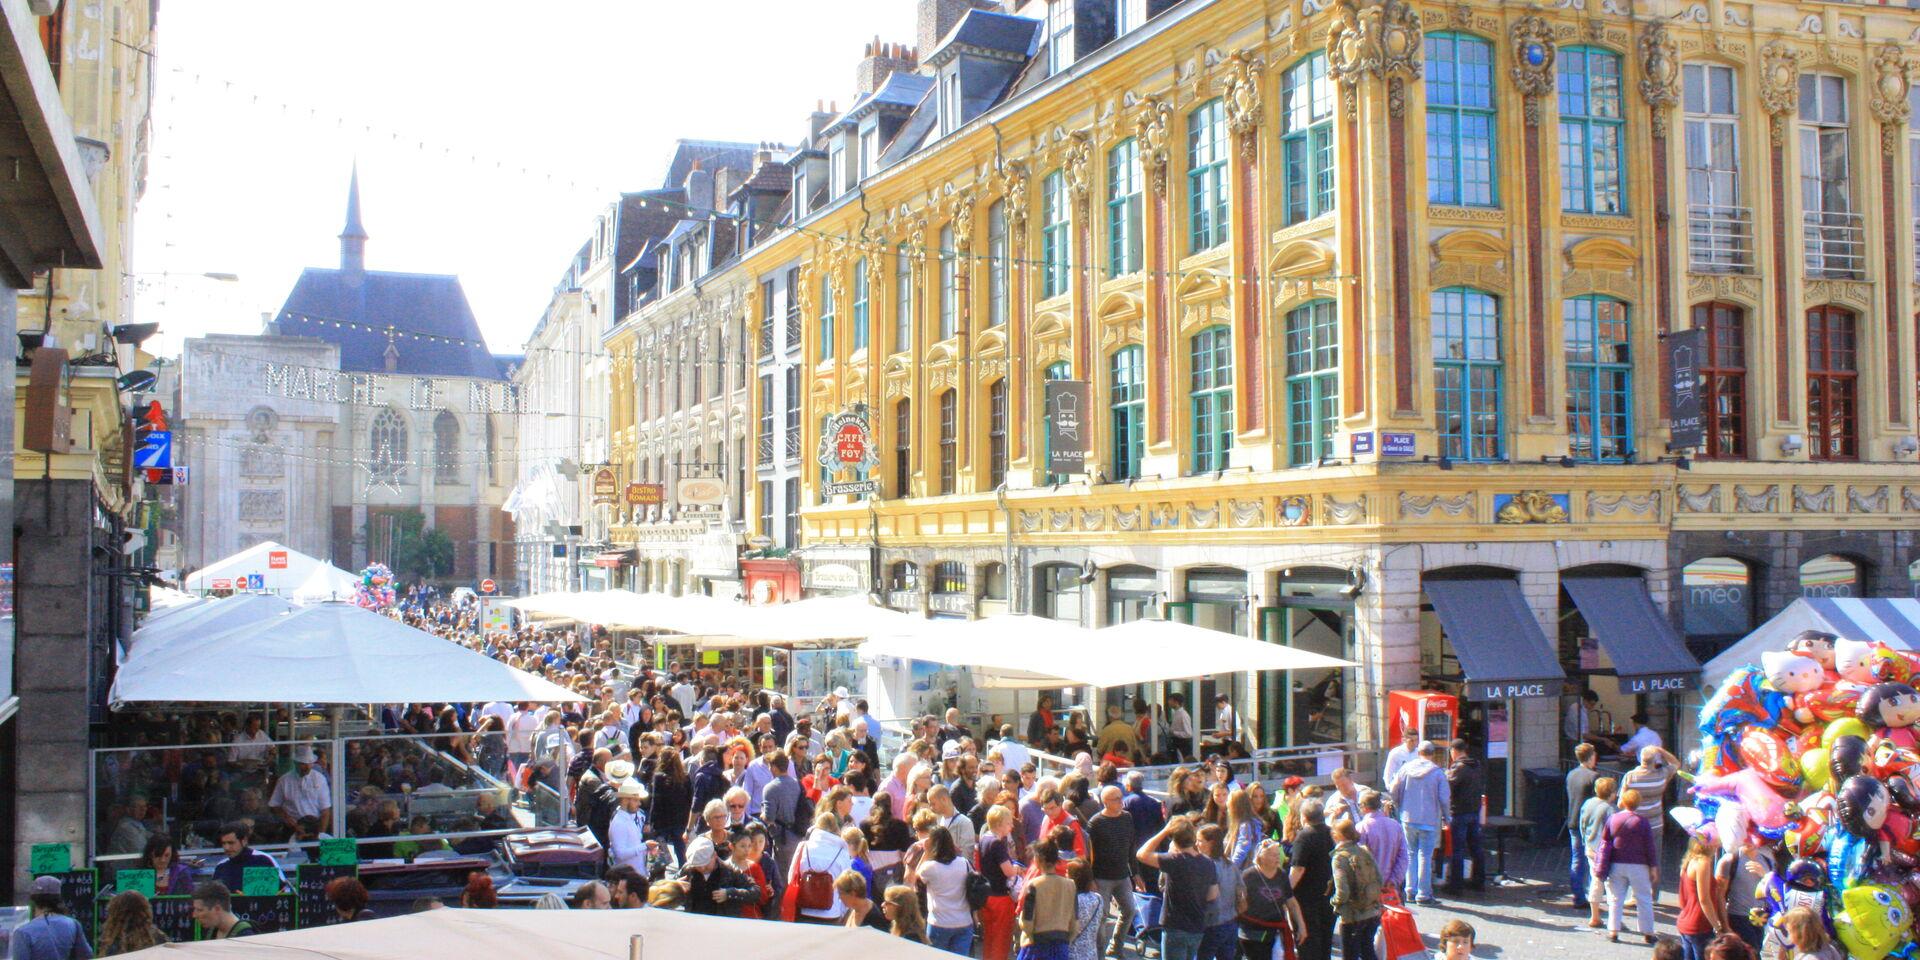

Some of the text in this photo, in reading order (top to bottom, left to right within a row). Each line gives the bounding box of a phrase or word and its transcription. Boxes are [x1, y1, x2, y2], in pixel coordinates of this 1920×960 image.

[832, 416, 870, 433] Heineken
[1670, 417, 1699, 428] LA PLACE
[841, 449, 860, 458] FOY
[632, 486, 656, 495] BISTRO
[825, 481, 873, 495] Brasserie
[1487, 684, 1544, 698] LA PLACE
[1632, 678, 1684, 692] LA PLACE
